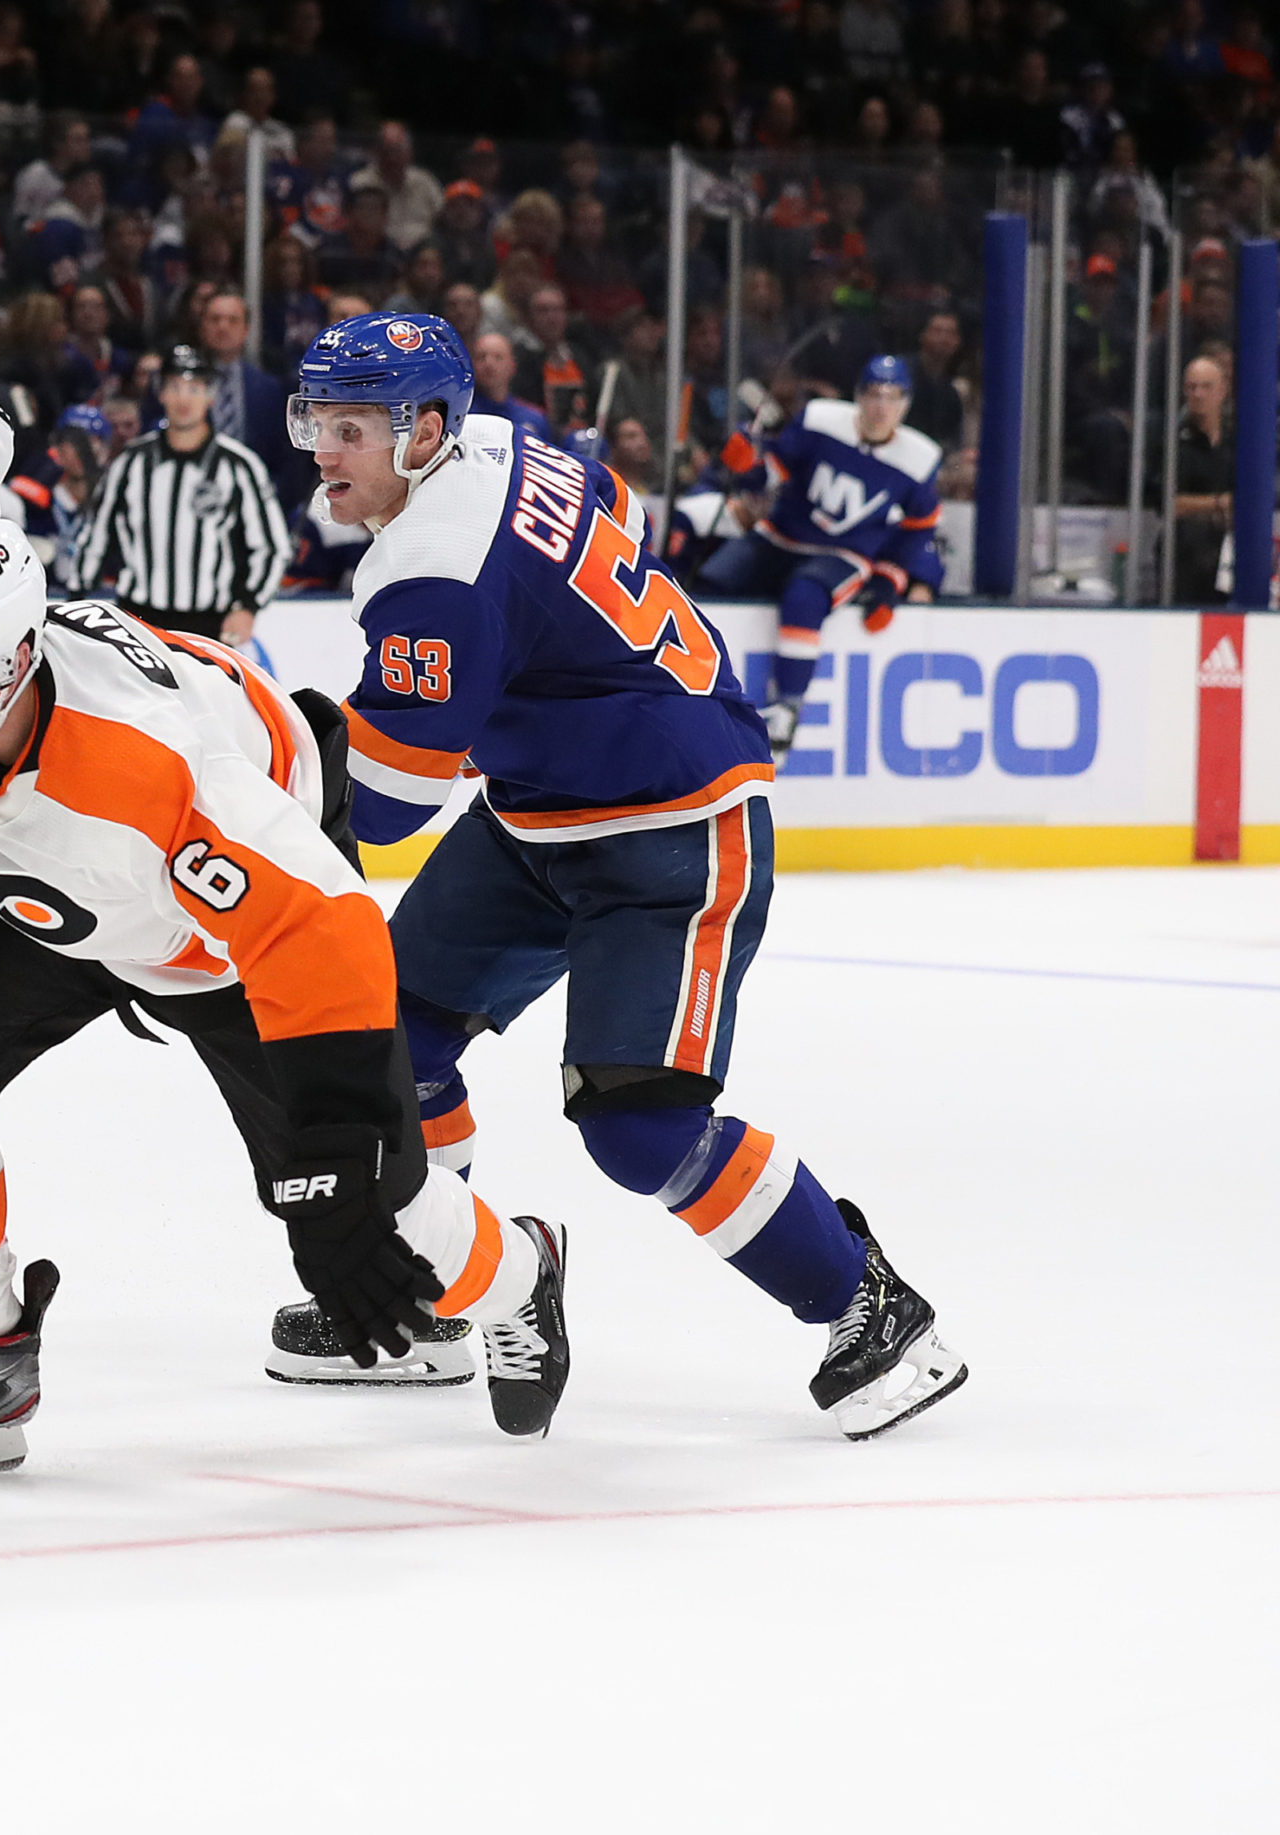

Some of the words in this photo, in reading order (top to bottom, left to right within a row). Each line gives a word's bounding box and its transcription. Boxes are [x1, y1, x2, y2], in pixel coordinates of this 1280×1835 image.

[567, 506, 721, 696] 5
[380, 634, 452, 703] 53
[744, 652, 1099, 778] EICO
[170, 837, 250, 913] 6
[690, 968, 712, 1039] WARRIOR
[272, 1174, 338, 1204] UER
